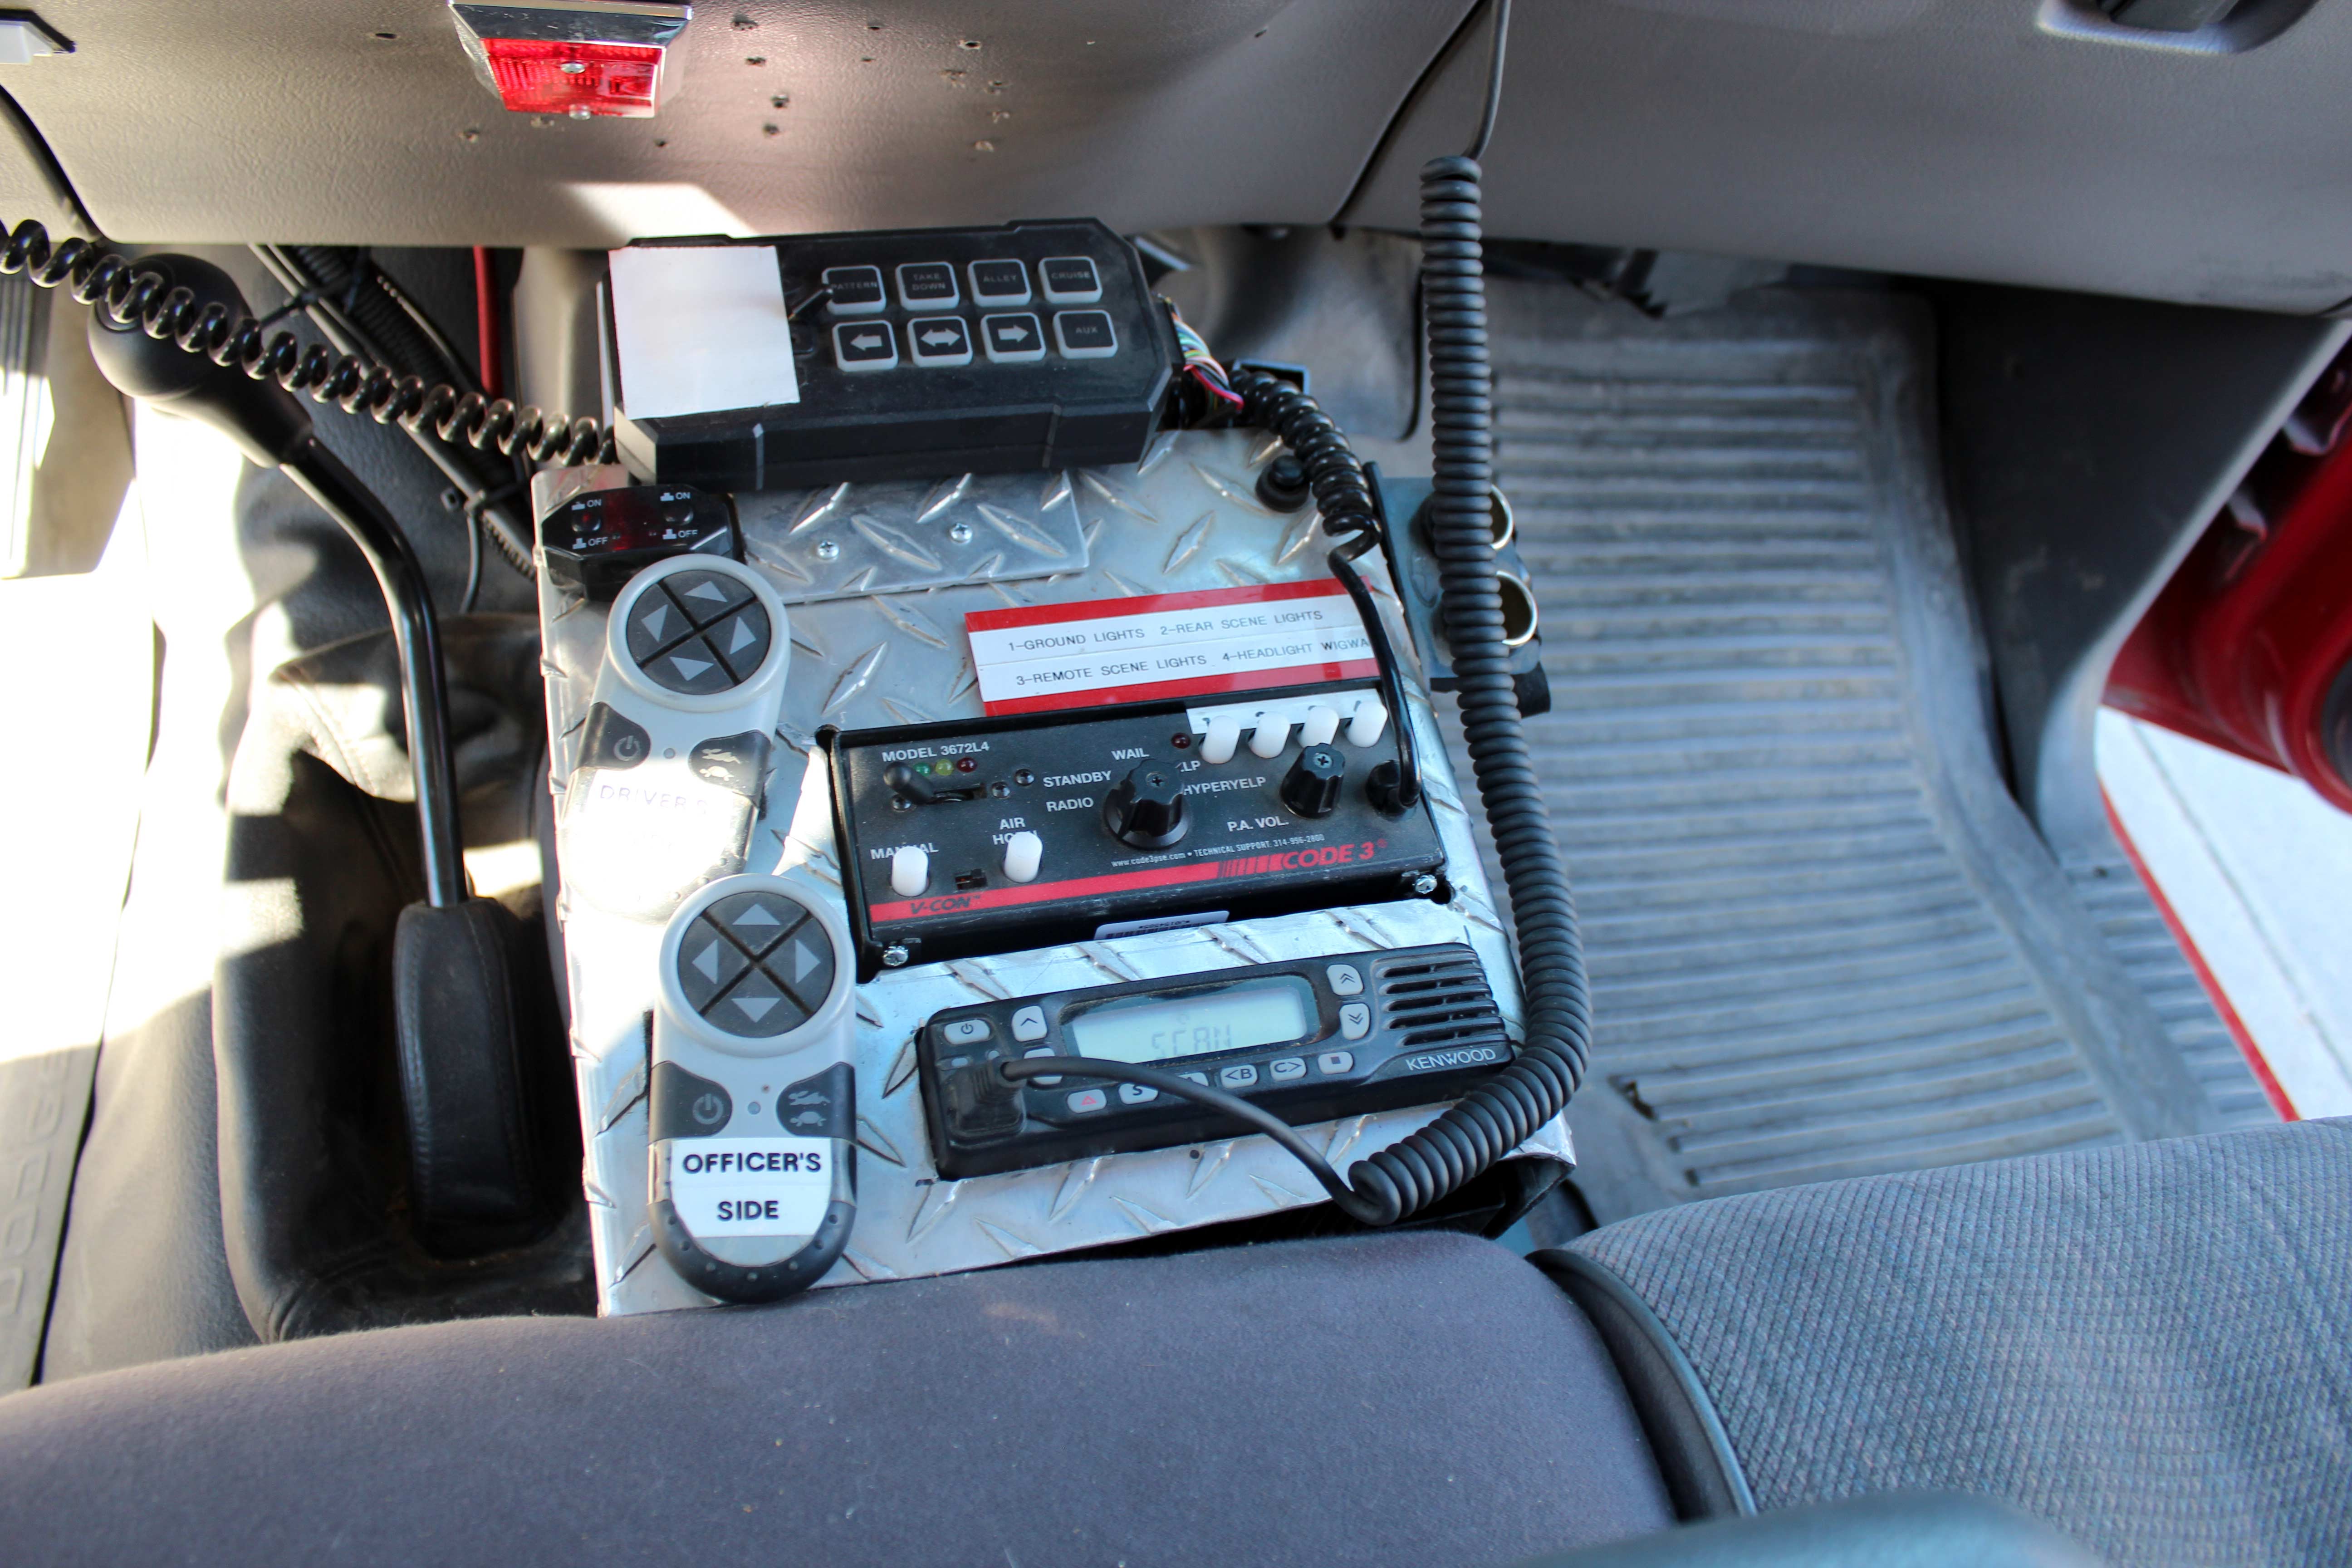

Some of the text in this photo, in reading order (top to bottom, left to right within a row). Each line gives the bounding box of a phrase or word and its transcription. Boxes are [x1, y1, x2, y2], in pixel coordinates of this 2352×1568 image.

[587, 499, 602, 508] ON
[675, 491, 691, 500] ON
[588, 537, 608, 546] OFF
[678, 529, 698, 538] OFF
[1009, 611, 1323, 651] 1-GROUND LIGHTS 2-REAR SCENE LIGHTS
[1016, 637, 1369, 685] 3-REMOTE SCENE LIGHTS 4-HEADLIGHT WIGWA
[882, 741, 990, 762] MODEL 3672L4
[1112, 748, 1150, 760] WAIL
[1043, 770, 1112, 787] STANDBY
[1183, 776, 1266, 795] HYPERYELP
[1046, 797, 1094, 812] RADIO
[1000, 817, 1026, 830] AIR
[1227, 816, 1289, 832] P.A. VOL.
[992, 830, 1038, 845] HO
[870, 843, 939, 859] MAAL
[1193, 845, 1235, 857] TECHNICAL
[1282, 843, 1355, 870] CODE
[1151, 1024, 1232, 1059] SCAN
[1406, 1048, 1496, 1071] KENWOOD
[682, 1152, 822, 1174] OFFICER'S
[716, 1200, 779, 1221] SIDE
